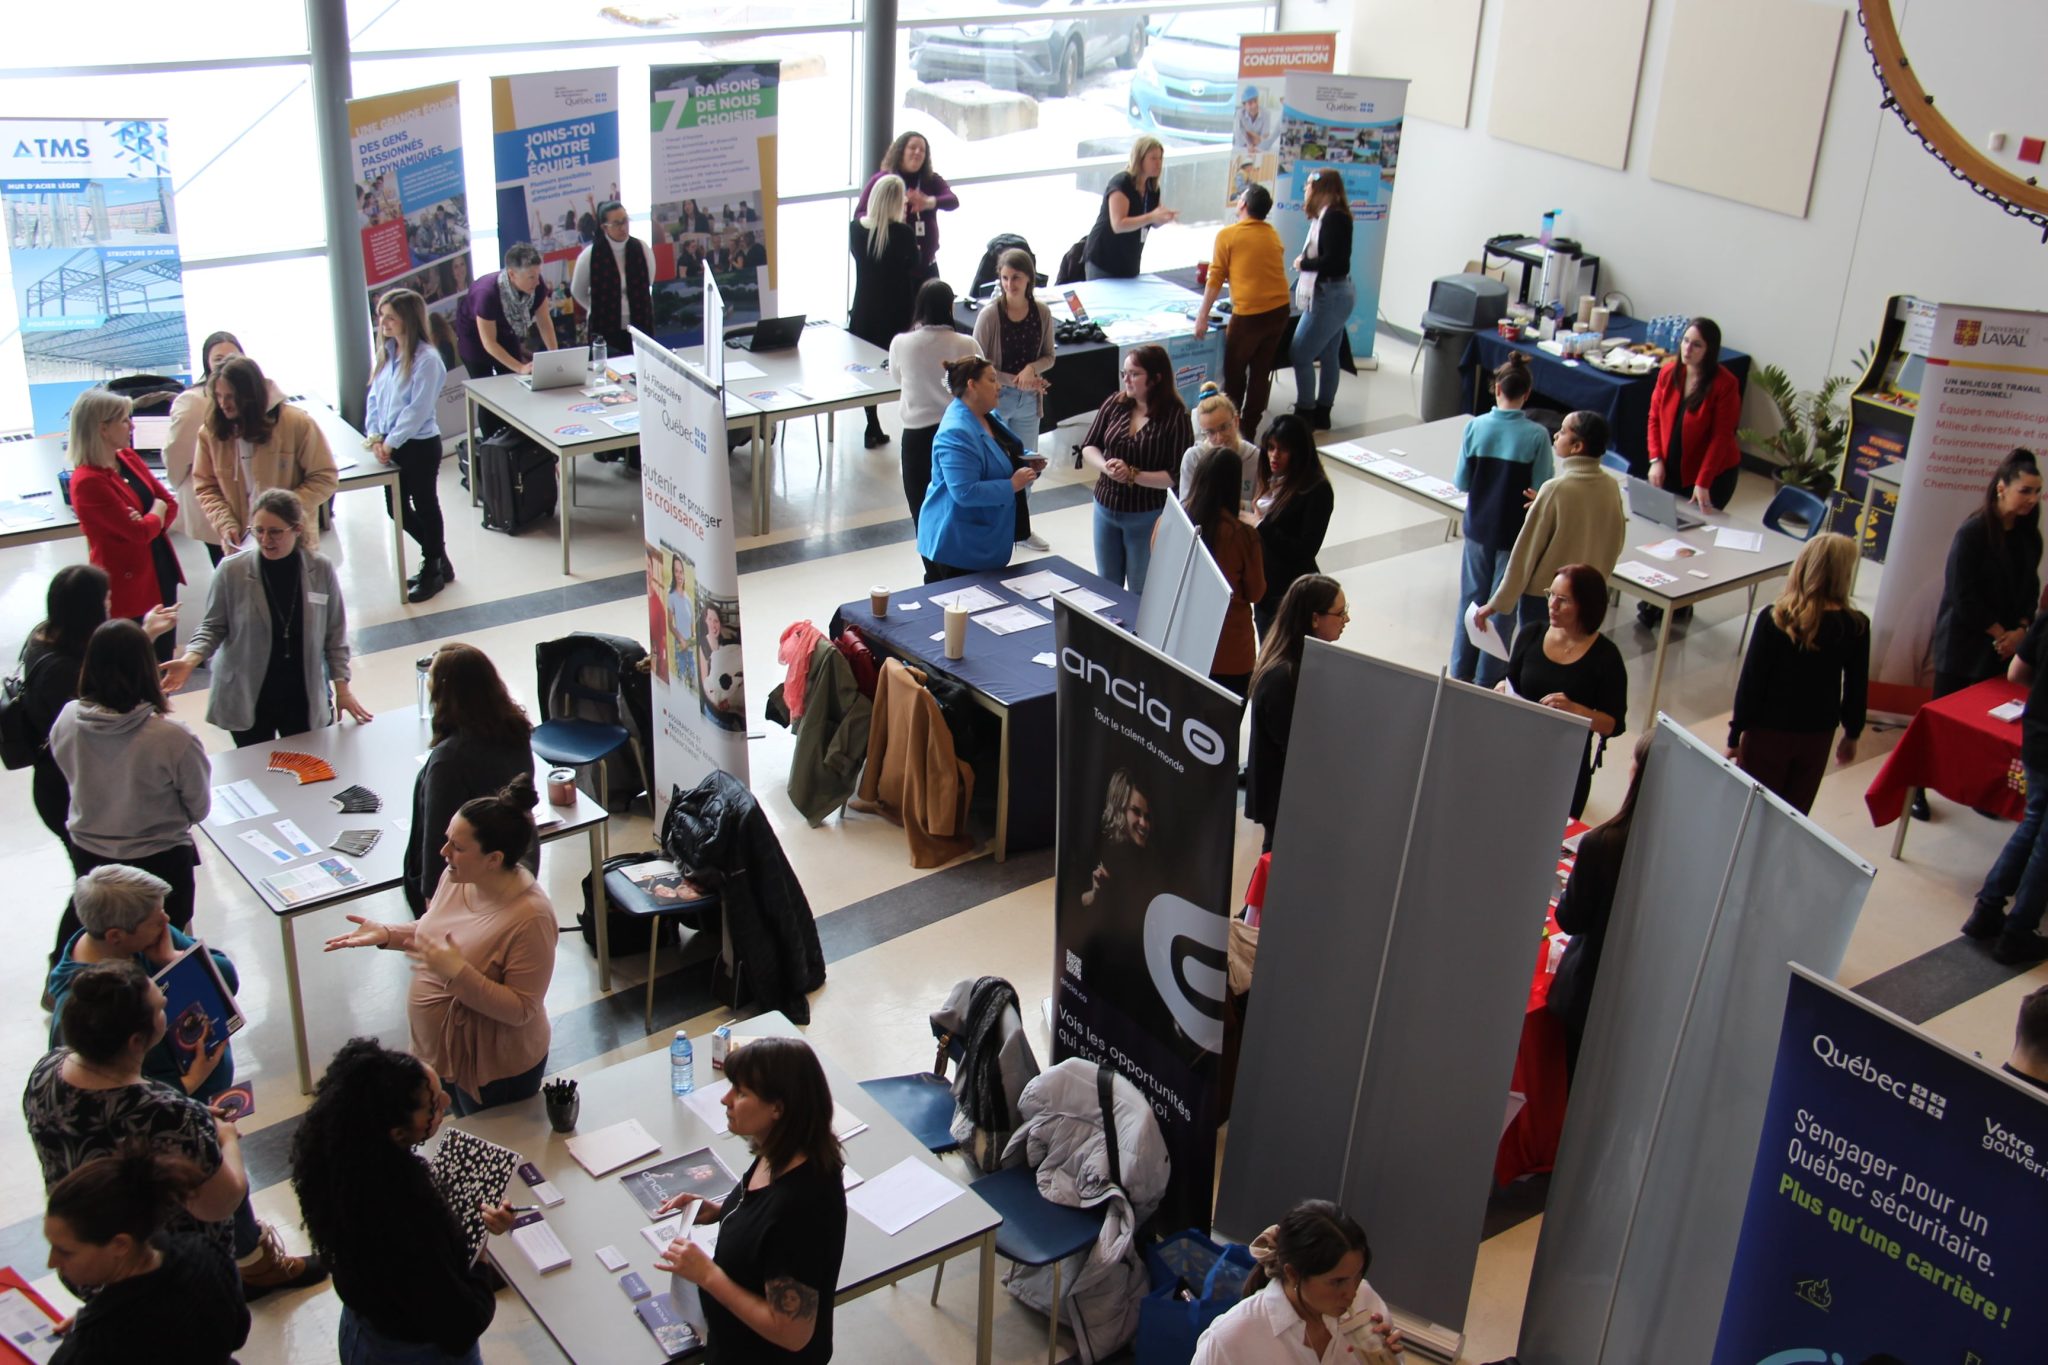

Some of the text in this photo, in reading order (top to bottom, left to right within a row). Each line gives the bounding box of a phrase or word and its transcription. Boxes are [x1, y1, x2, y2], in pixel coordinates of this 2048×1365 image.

[1243, 52, 1328, 66] CONSTRUCTION
[565, 96, 594, 107] Québec
[655, 79, 760, 132] 7 RAISONS
[696, 94, 761, 112] DE NOUS
[1326, 102, 1358, 112] Québec
[697, 108, 757, 126] CHOISIR
[360, 130, 408, 155] DES GENS
[525, 122, 595, 147] JOINS-TOI
[12, 138, 91, 158] ATMS
[362, 138, 424, 167] PASSIONNÉS
[527, 138, 590, 162] À NOTRE
[364, 145, 444, 180] ET DYNAMIQUES
[528, 154, 589, 176] ÉQUIPE !
[7, 182, 26, 190] MUR
[27, 182, 57, 190] D'ACIER
[1982, 332, 2027, 348] LAVAL
[1984, 324, 2030, 334] UNIVERSITÉ
[643, 369, 682, 404] La Financière
[643, 386, 667, 407] agricole
[1944, 378, 2042, 394] UN MILIEU DE TRAVAIL
[1938, 402, 1982, 417] Équipes
[662, 410, 694, 444] Québec
[1936, 420, 1968, 432] Milieu
[1970, 423, 2022, 435] diversifié
[2024, 430, 2034, 438] et
[1932, 435, 2015, 452] Environnement
[1929, 451, 1985, 466] Avantages
[642, 463, 722, 529] outenir et protéger
[1922, 478, 1988, 492] Chemineme
[644, 478, 704, 542] la croissance
[1061, 647, 1172, 734] ancia
[1093, 706, 1184, 774] Tout le talent du monde
[1060, 976, 1088, 1004] ancia.ca
[1058, 1028, 1078, 1049] qui
[1058, 1004, 1192, 1123] Vois les opportunités
[1812, 1034, 1906, 1100] Québec
[1986, 1117, 2034, 1157] Votre
[1982, 1134, 2048, 1178] gouvern
[642, 1171, 668, 1200] ancia
[1794, 1108, 1989, 1238] S'engager pour un
[1788, 1138, 1996, 1278] Québec sécuritaire.
[1778, 1172, 2012, 1330] Plus qu'une carrière !
